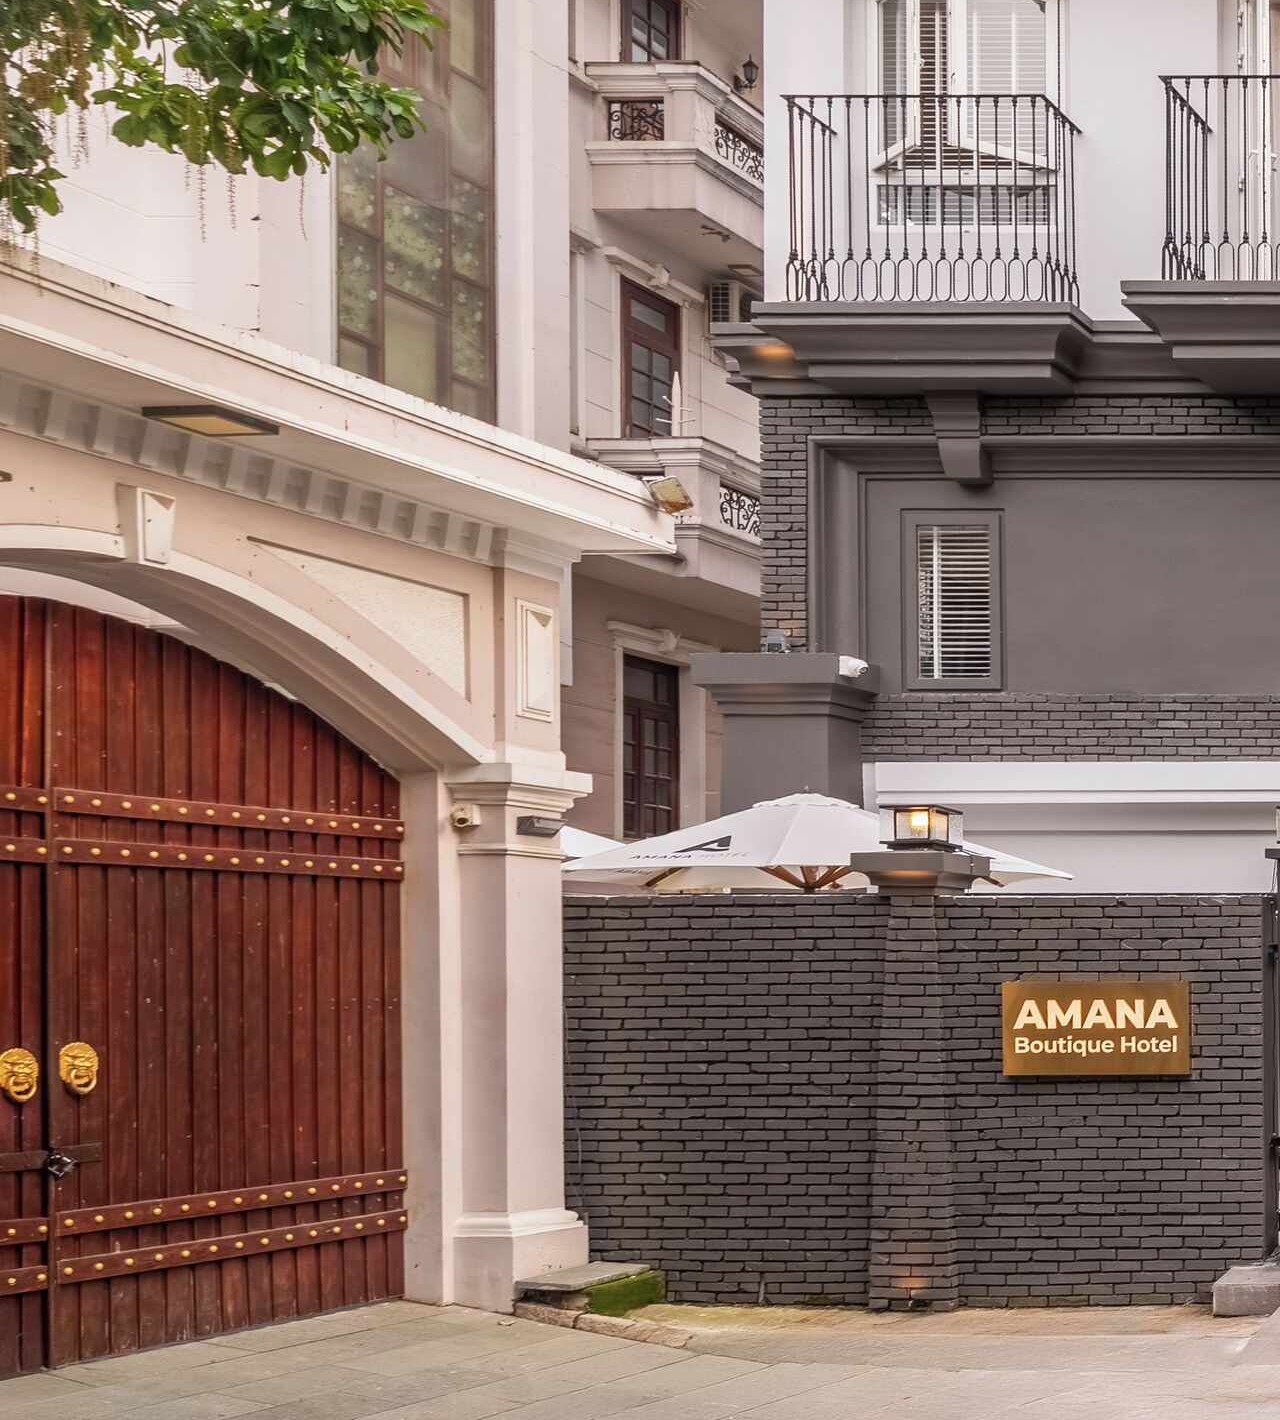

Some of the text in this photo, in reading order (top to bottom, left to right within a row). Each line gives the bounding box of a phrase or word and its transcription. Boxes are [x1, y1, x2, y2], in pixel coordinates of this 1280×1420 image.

[1013, 999, 1179, 1029] AMANA
[1014, 1035, 1178, 1057] Boutique Hotel
